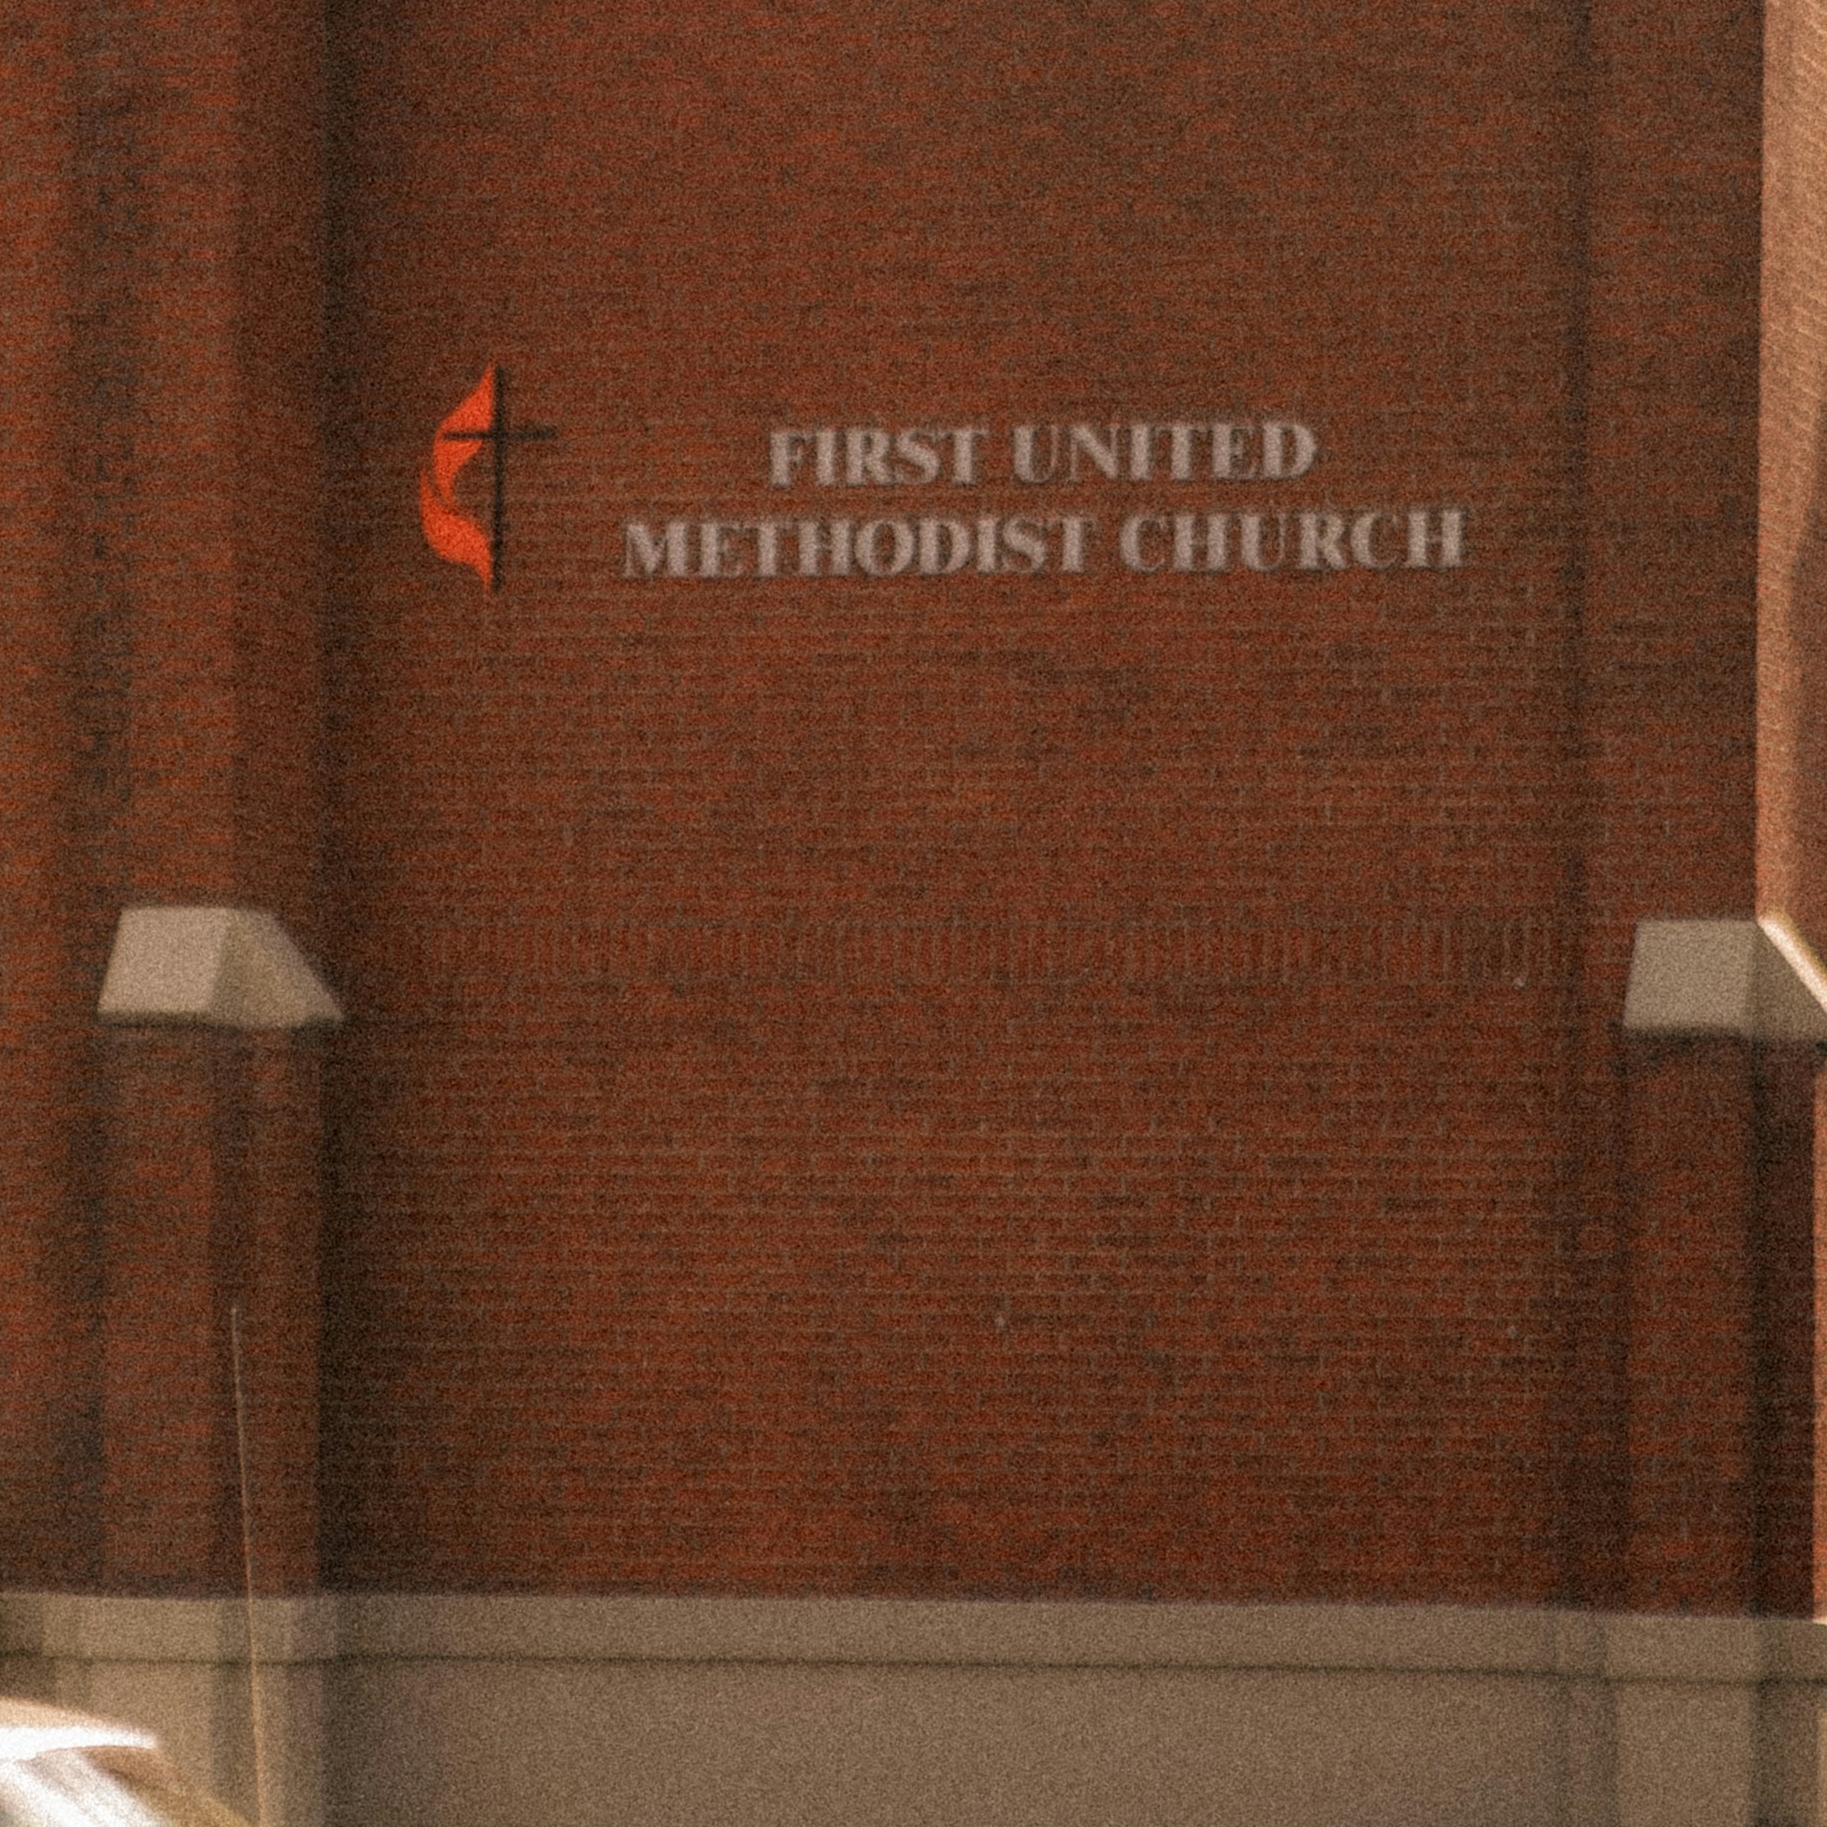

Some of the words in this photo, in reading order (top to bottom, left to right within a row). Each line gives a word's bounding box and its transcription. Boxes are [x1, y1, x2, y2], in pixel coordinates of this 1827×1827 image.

[771, 424, 985, 488] FIRST
[1011, 421, 1319, 484] UNITED
[623, 513, 1098, 579] METHODIST
[1119, 506, 1467, 572] CHURCH
